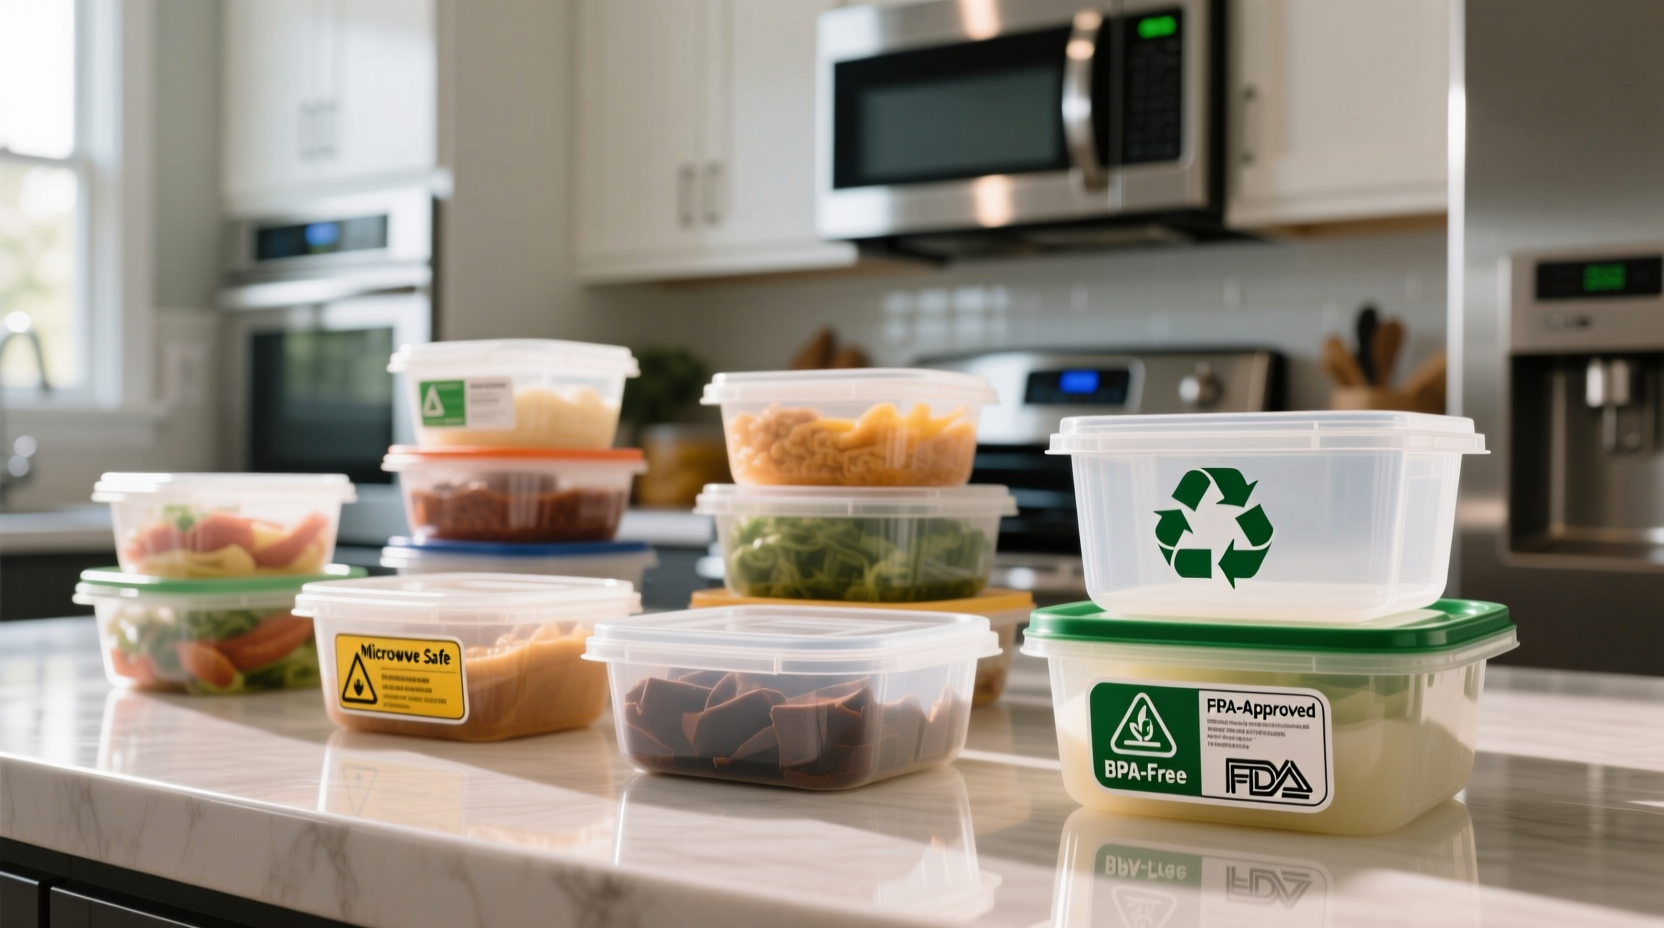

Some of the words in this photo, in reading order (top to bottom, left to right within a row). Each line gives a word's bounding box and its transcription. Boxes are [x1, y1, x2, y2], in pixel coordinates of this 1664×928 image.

[423, 648, 451, 665] Safe
[1104, 759, 1187, 784] BPA-Free
[1226, 758, 1313, 800] FDA
